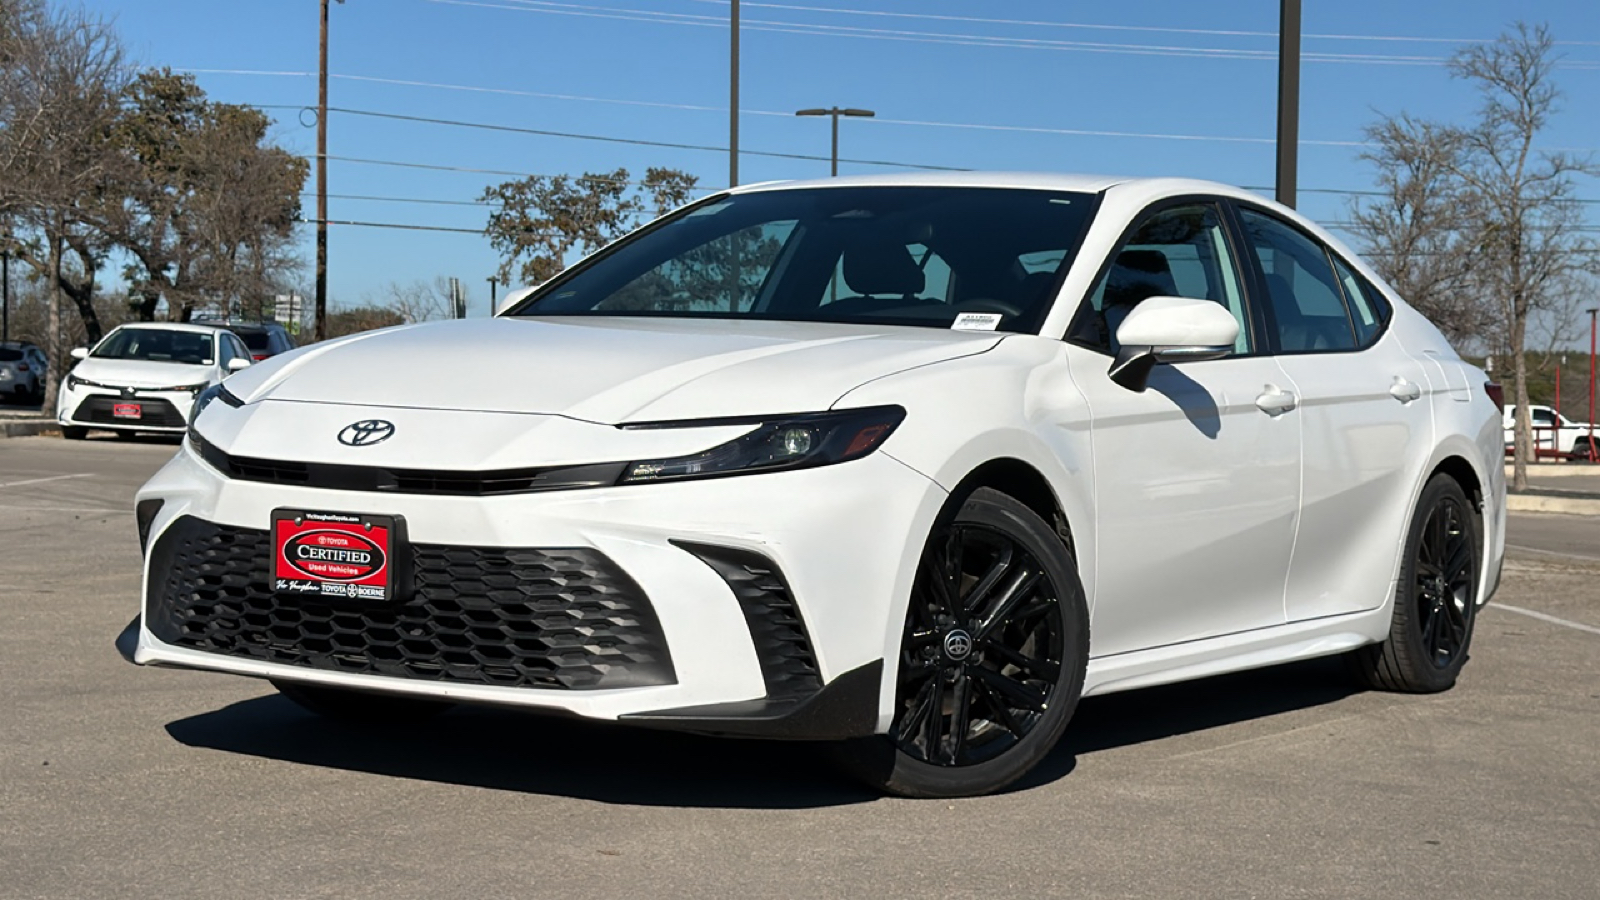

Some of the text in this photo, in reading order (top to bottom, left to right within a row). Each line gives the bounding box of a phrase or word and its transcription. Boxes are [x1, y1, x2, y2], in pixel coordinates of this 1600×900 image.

[326, 537, 349, 545] TOYOTA
[308, 563, 359, 575] Used Vehicles
[322, 584, 385, 597] TOYOTA BOERNE
